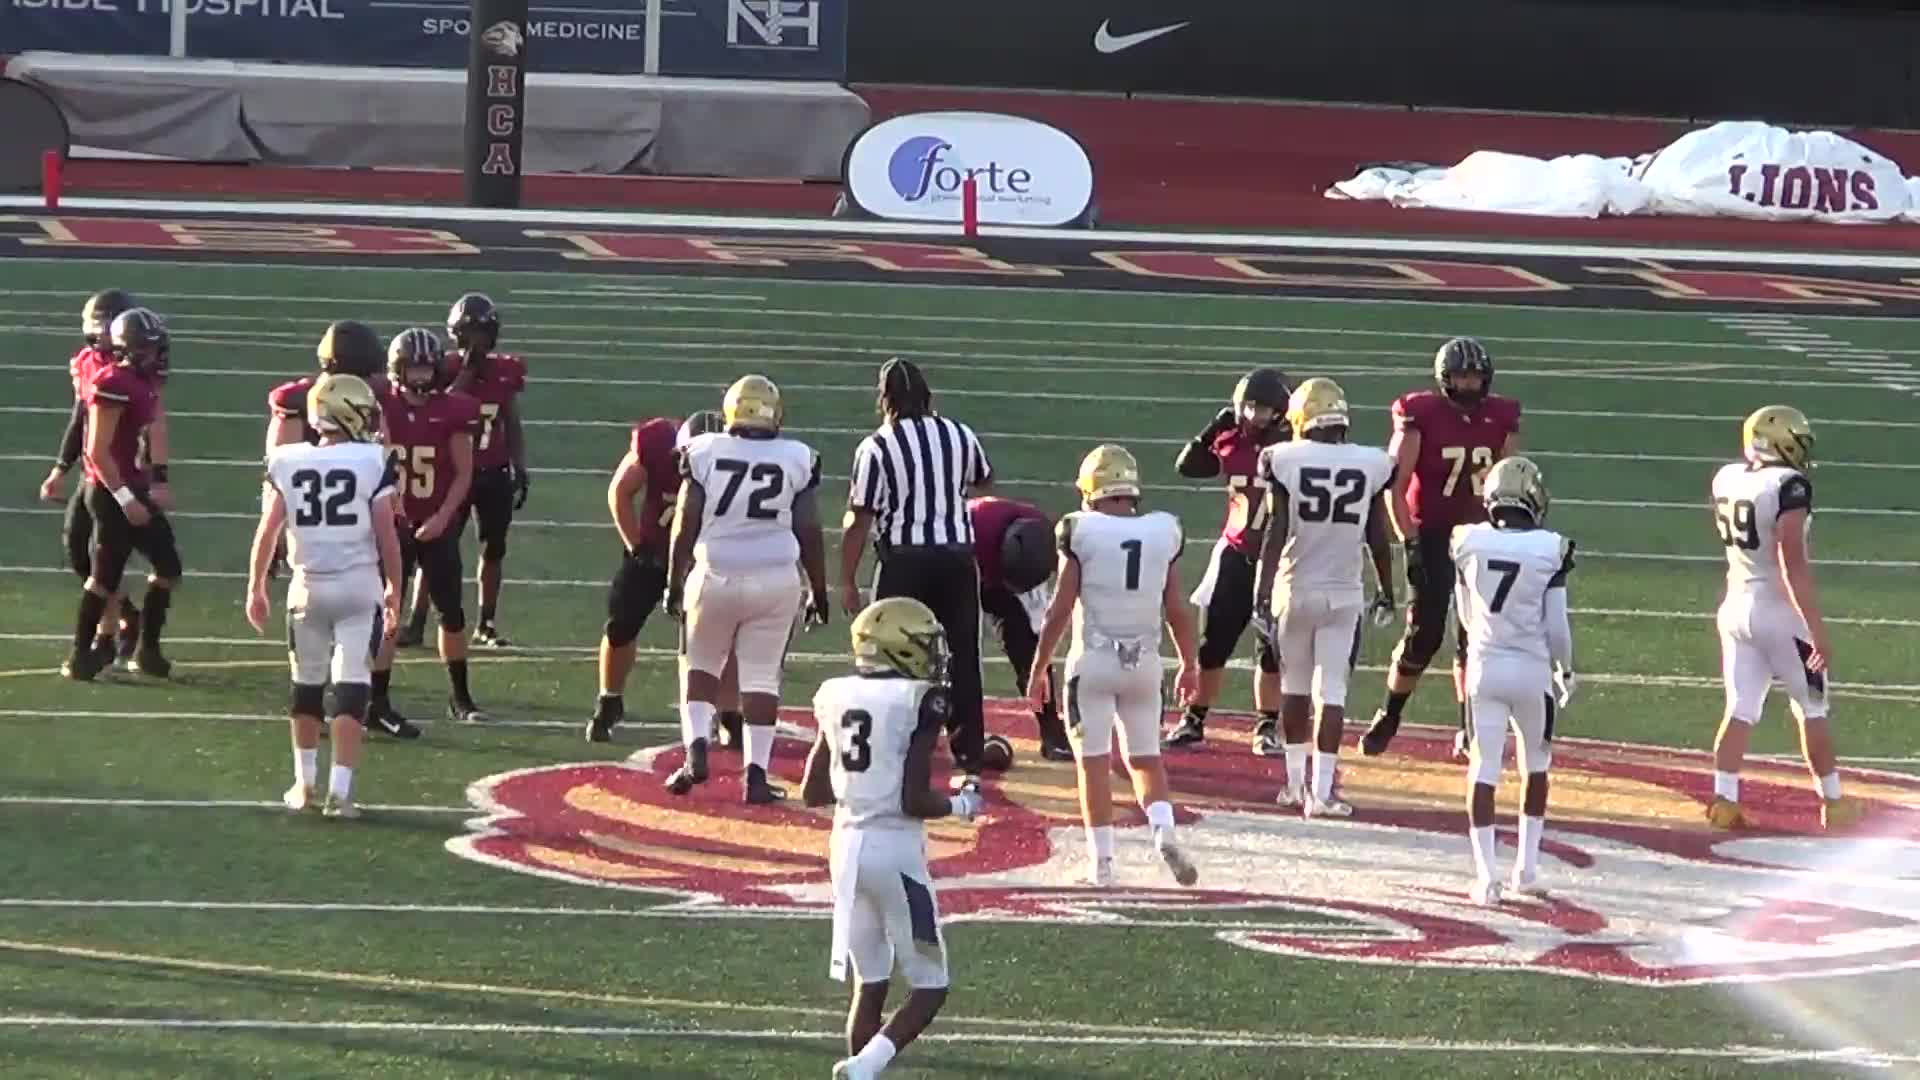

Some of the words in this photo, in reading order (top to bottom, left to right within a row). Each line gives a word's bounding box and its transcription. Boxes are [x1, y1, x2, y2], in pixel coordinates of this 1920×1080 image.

[422, 18, 471, 36] SPO
[903, 142, 1032, 202] forte
[1728, 163, 1879, 214] LIONS
[291, 468, 359, 527] 32
[713, 458, 784, 520] 72
[1228, 475, 1275, 531] 57
[1298, 466, 1367, 526] 52
[1120, 539, 1143, 591] 1
[1487, 559, 1521, 613] 7
[841, 708, 873, 774] 3
